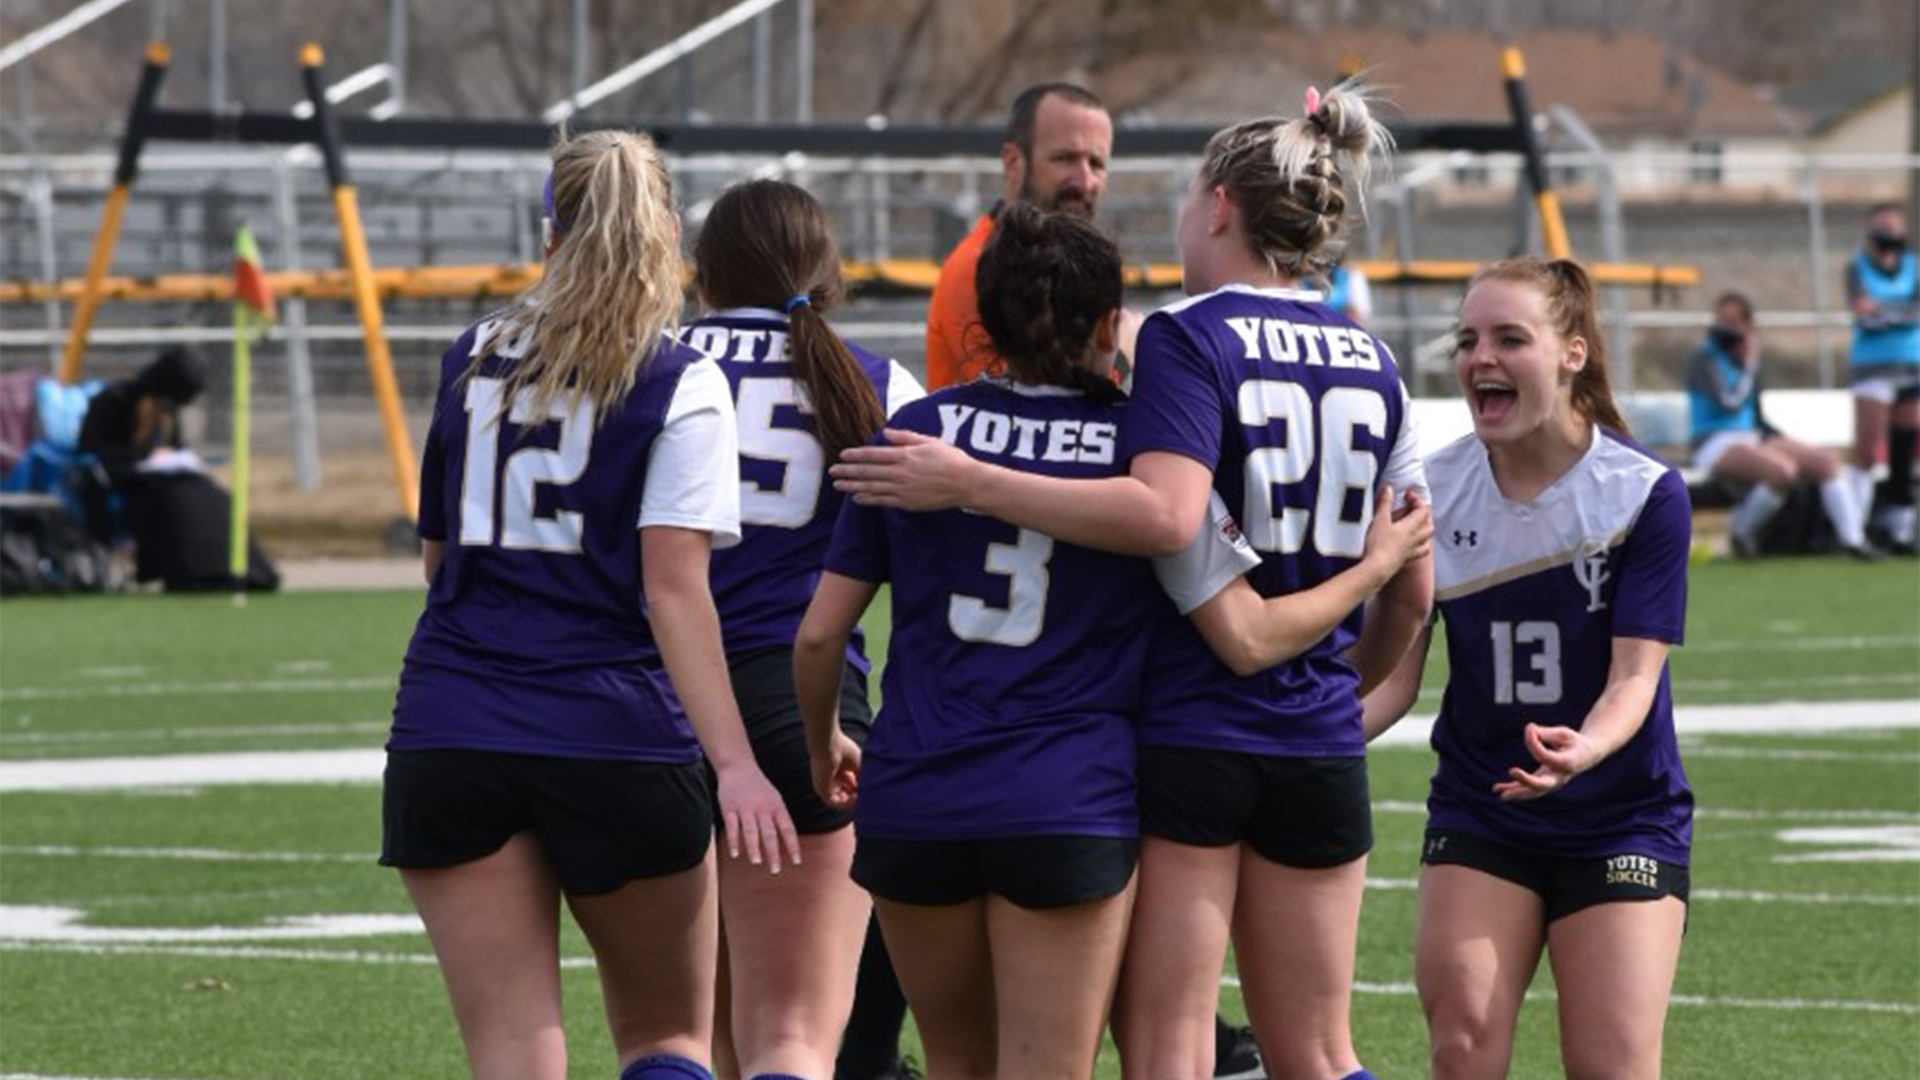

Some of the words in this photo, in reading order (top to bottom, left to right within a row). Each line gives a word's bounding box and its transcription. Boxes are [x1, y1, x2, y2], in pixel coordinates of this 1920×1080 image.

[679, 325, 793, 364] OTE
[1225, 317, 1381, 372] YOTES
[460, 376, 597, 554] 12
[937, 403, 1117, 465] YOTES
[1238, 379, 1388, 559] 26
[948, 508, 1054, 648] 3
[1490, 620, 1563, 705] 13
[1606, 854, 1658, 875] YOTES
[1606, 870, 1658, 889] SOCCER
